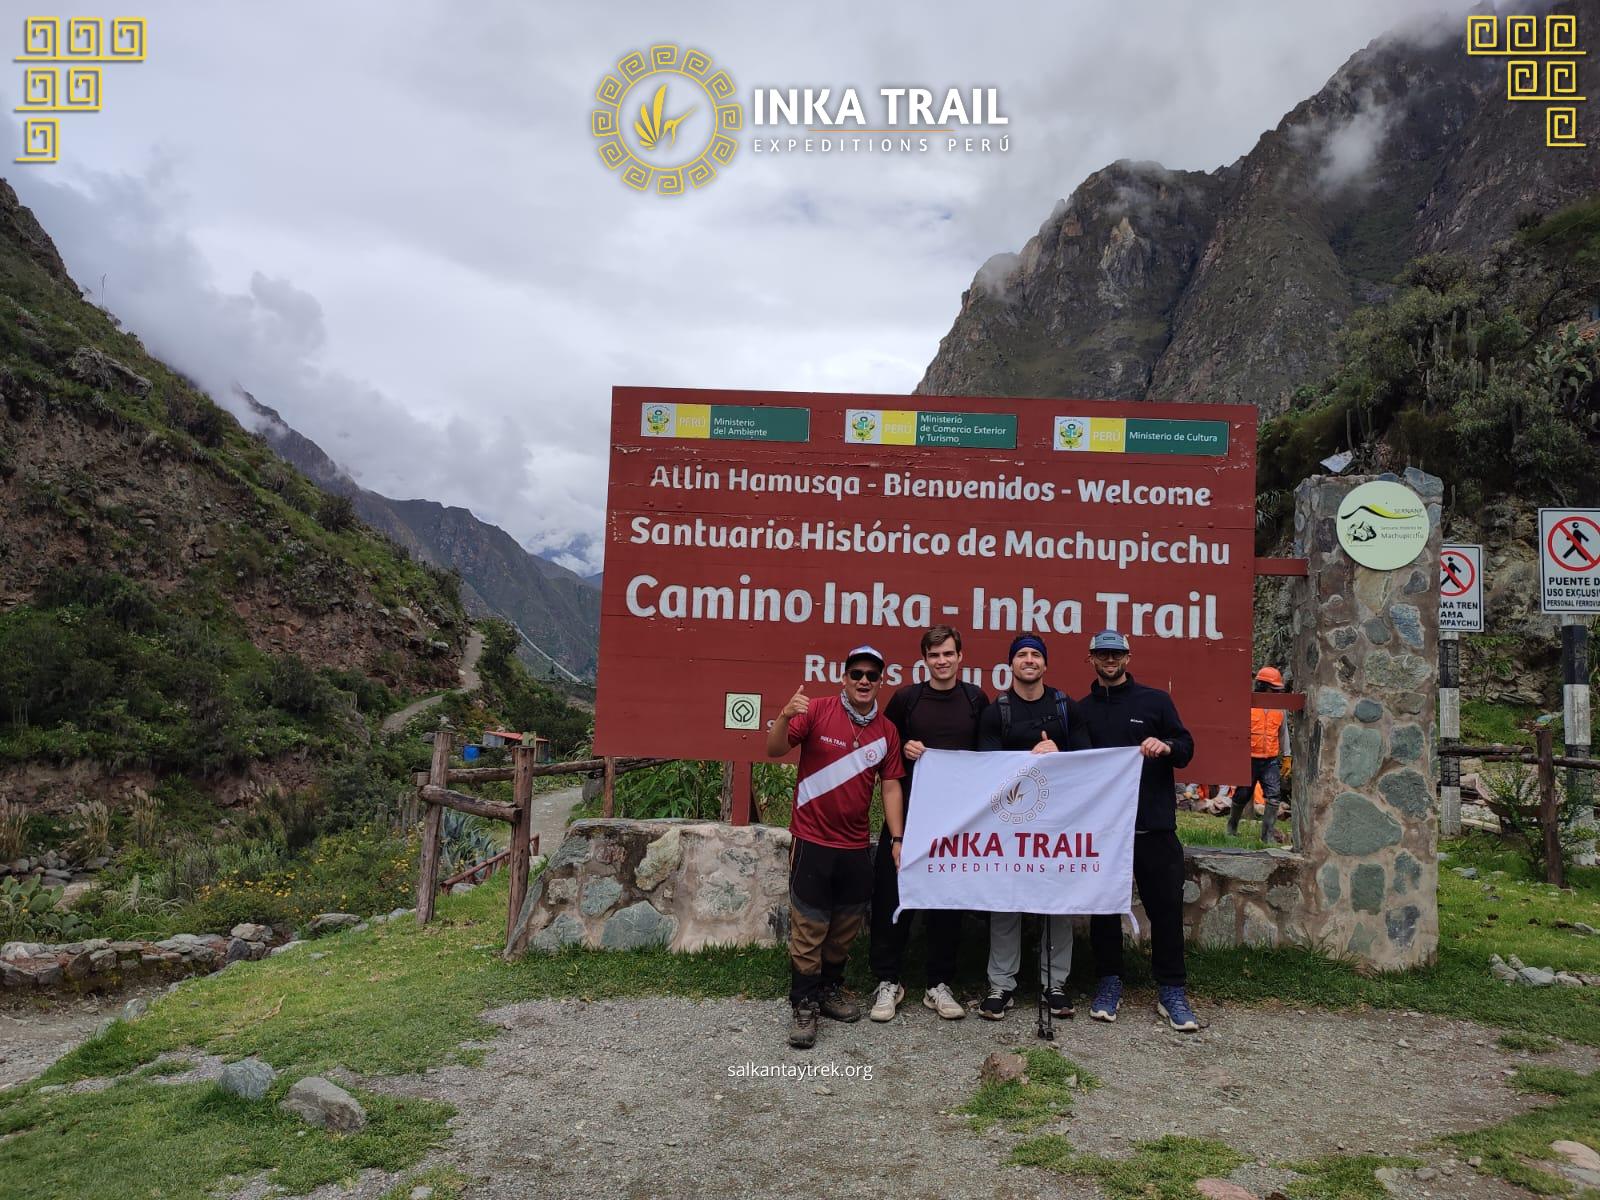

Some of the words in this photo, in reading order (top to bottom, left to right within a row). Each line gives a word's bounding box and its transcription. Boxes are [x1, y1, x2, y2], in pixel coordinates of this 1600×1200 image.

[714, 417, 755, 427] Ministerio
[921, 415, 963, 424] Ministerio
[713, 427, 726, 435] del
[727, 428, 768, 437] Ambiente
[932, 425, 972, 434] Comercio
[974, 426, 1007, 435] Exterior
[920, 435, 925, 443] y
[926, 434, 960, 443] Turismo
[1129, 431, 1172, 441] Ministerio
[1174, 432, 1185, 441] de
[1187, 433, 1218, 442] Cultura
[650, 464, 720, 489] Allin
[728, 467, 860, 500] Hamusqa
[883, 471, 1055, 502] Bienvenidos
[1077, 478, 1211, 506] Welcome
[630, 516, 794, 550] Santuario
[801, 519, 951, 556] Histórico
[957, 527, 997, 557] de
[1004, 529, 1230, 569] Machupicchu
[1548, 577, 1591, 586] PUENTE
[1547, 589, 1564, 597] USO
[625, 574, 813, 623] Camino
[823, 582, 931, 628] Inka
[942, 605, 959, 615] -
[972, 587, 1082, 634] Inka
[1096, 591, 1224, 640] Trail
[1456, 601, 1478, 610] TREN
[928, 832, 1004, 858] INKA
[1014, 832, 1099, 858] TRAIL
[928, 862, 1046, 873] EXPEDITIONS
[1059, 861, 1100, 873] PERÚ
